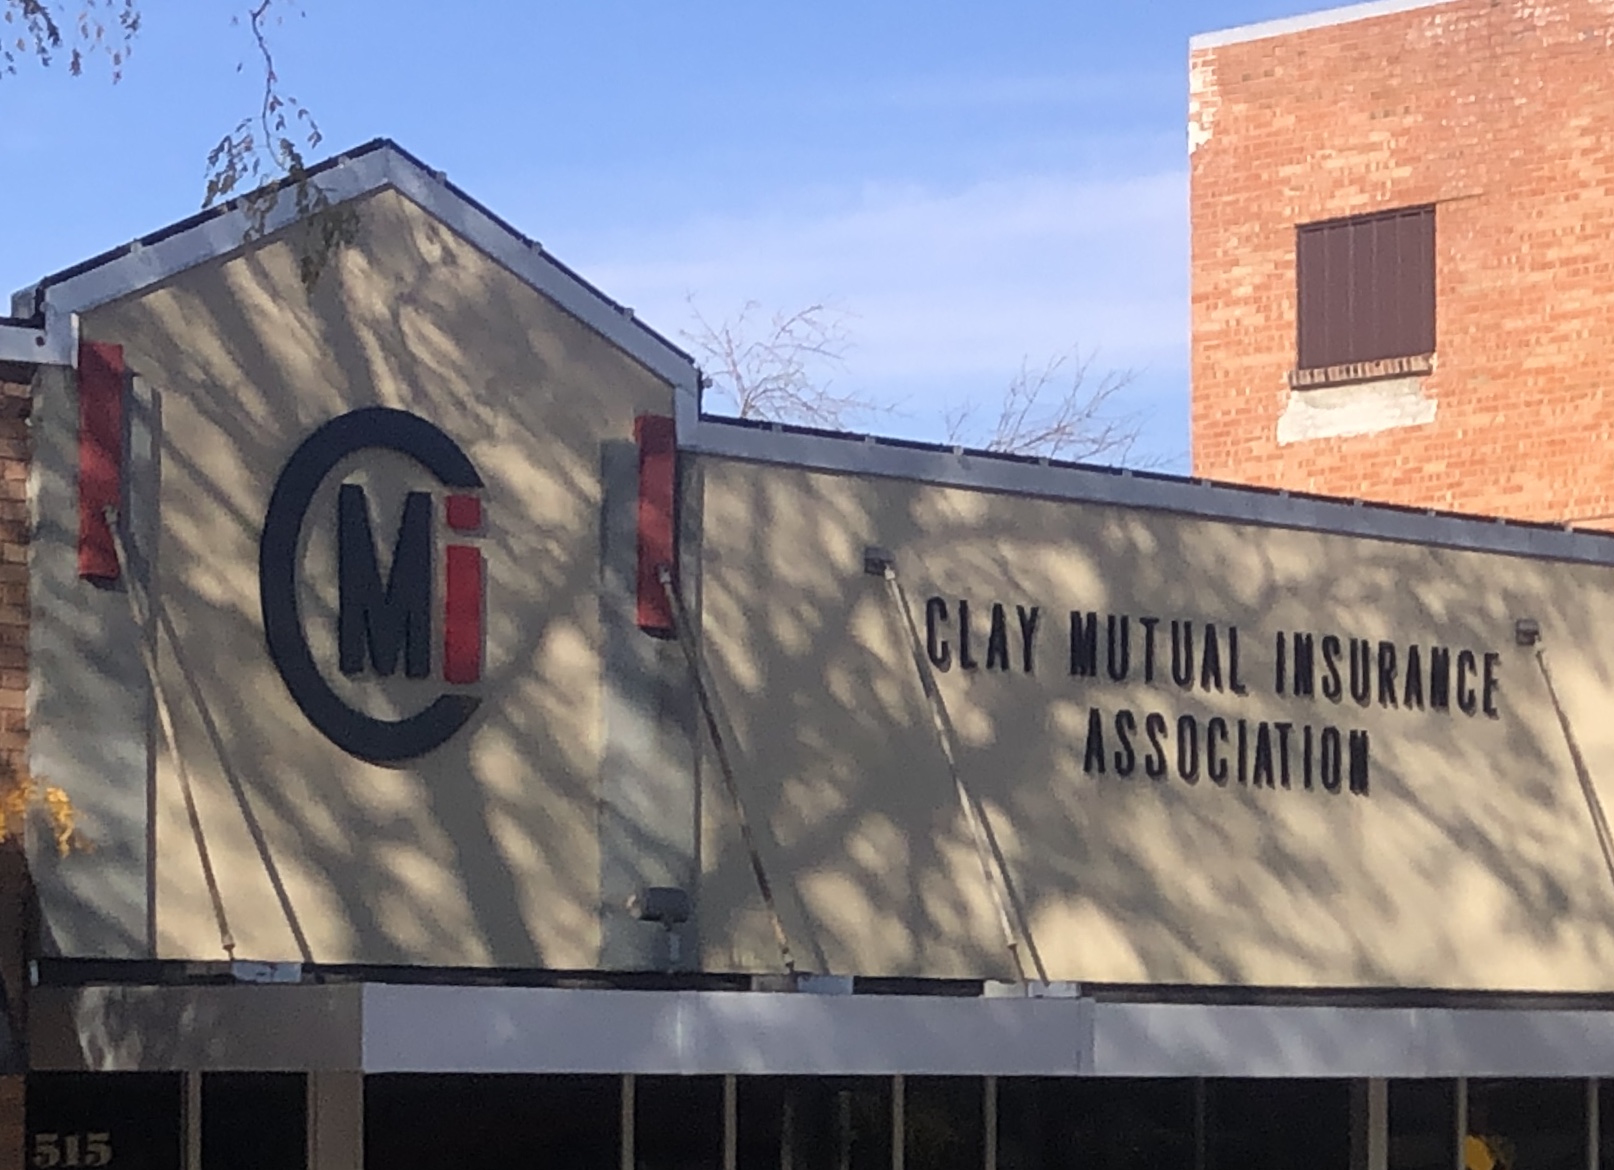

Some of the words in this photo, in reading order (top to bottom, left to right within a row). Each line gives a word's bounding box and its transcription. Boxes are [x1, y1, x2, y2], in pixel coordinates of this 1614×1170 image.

[924, 597, 1041, 676] CLAY
[1070, 610, 1250, 697] MUTUAL
[1275, 630, 1501, 719] INSURANCE
[1083, 707, 1371, 796] ASSOCIATION
[32, 1132, 113, 1169] 515
